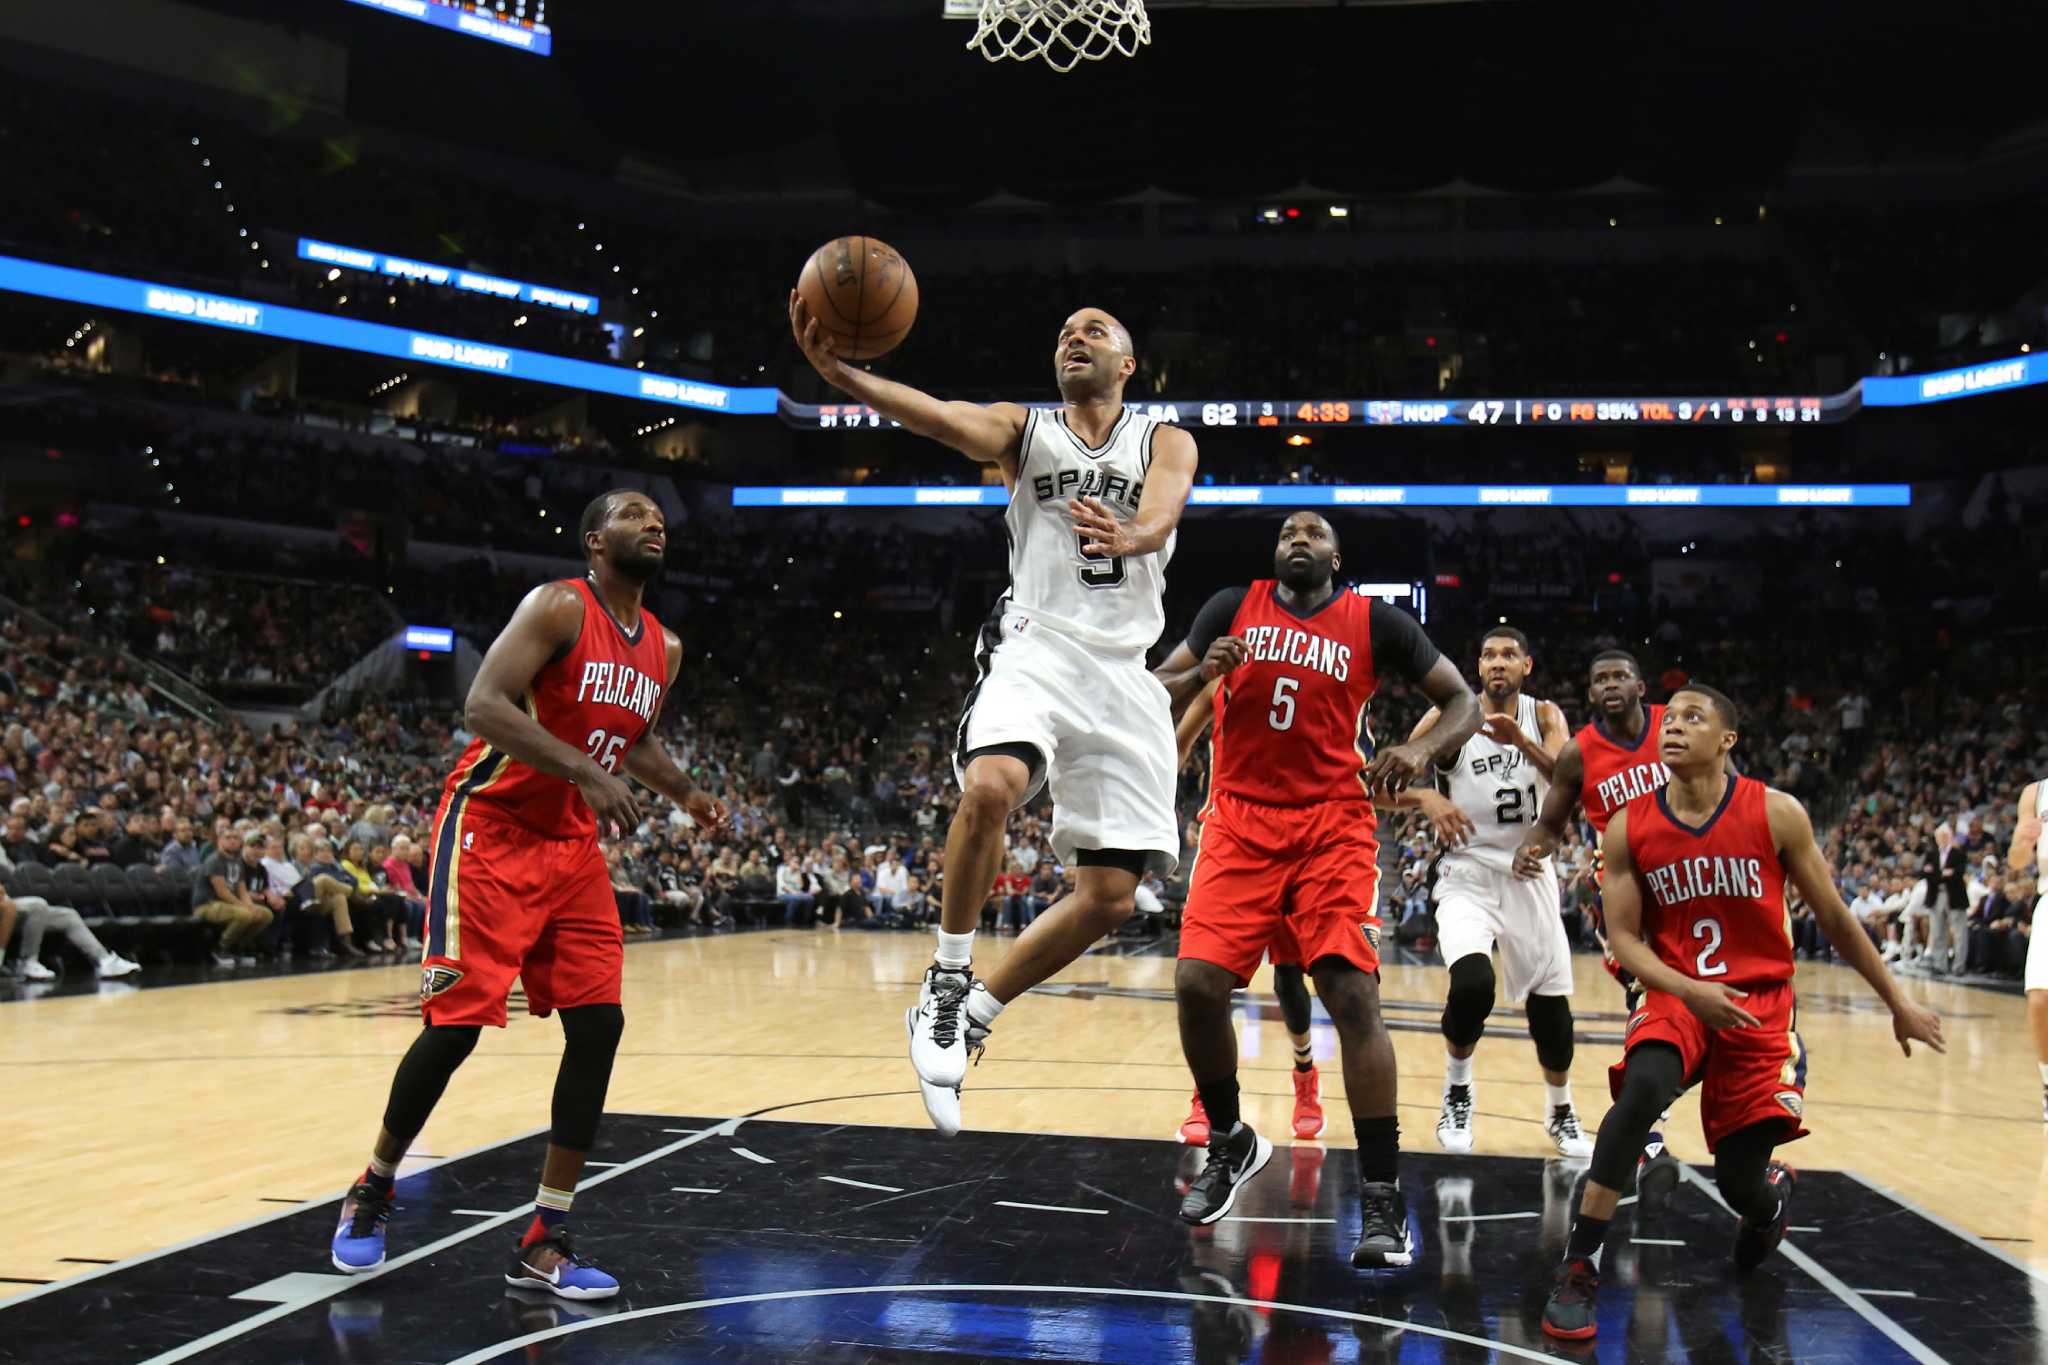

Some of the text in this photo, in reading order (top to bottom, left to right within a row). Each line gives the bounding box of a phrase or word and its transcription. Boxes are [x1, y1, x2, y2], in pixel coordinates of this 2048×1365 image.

[148, 290, 258, 325] BUD LIGHT
[413, 337, 508, 368] BUD LIGHT
[642, 378, 726, 406] BUD LIGHT
[1923, 362, 2024, 396] BUD LIGHT
[844, 414, 862, 427] 17
[1202, 403, 1237, 425] 62
[1262, 402, 1273, 415] 3
[1297, 403, 1349, 421] 4:33
[1403, 401, 1504, 424] NOP 47
[1532, 404, 1543, 420] F
[1547, 403, 1561, 420] 0
[1571, 403, 1594, 420] FG
[1597, 403, 1638, 419] 35%
[1640, 403, 1673, 419] TOL
[1678, 402, 1692, 420] 3
[1710, 402, 1720, 419] 1
[1077, 522, 1127, 588] 9
[1243, 626, 1351, 682] PELICANS
[577, 662, 661, 722] PELICANS
[1268, 676, 1299, 731] 5
[1494, 784, 1538, 824] 21
[1645, 856, 1763, 907] PELICANS
[1692, 917, 1728, 977] 2
